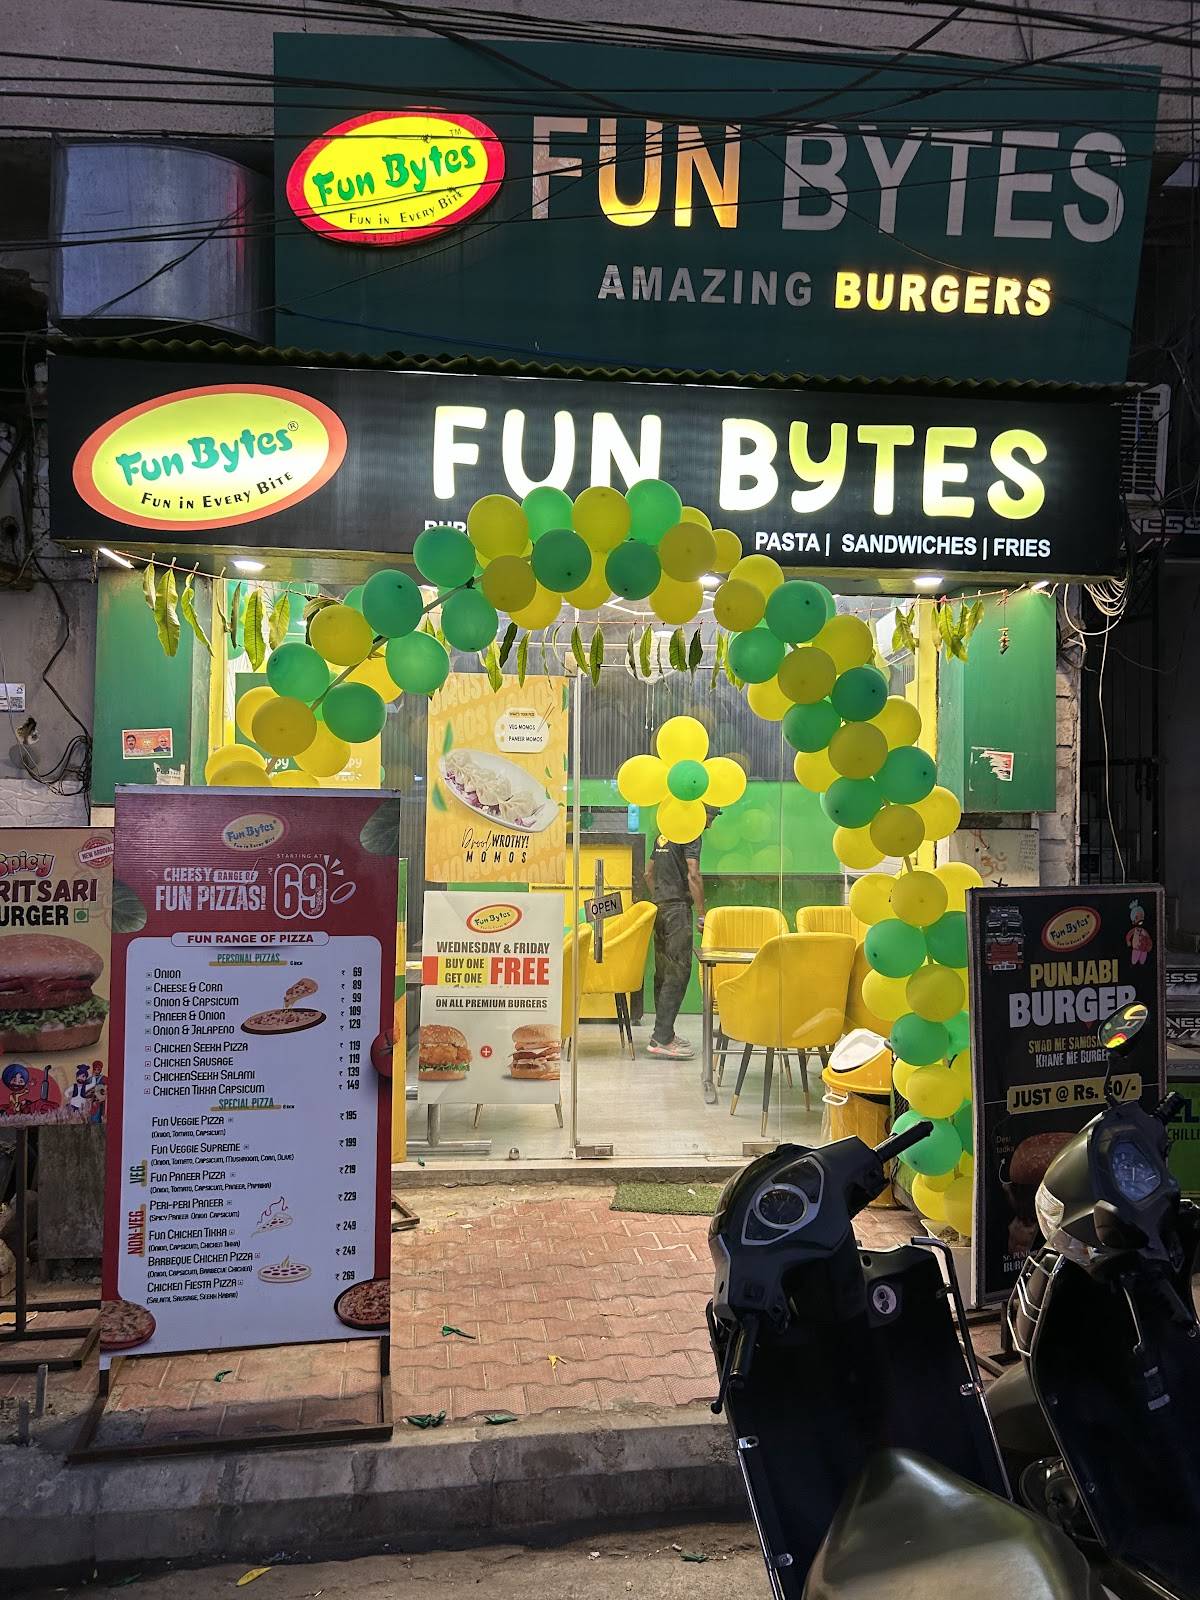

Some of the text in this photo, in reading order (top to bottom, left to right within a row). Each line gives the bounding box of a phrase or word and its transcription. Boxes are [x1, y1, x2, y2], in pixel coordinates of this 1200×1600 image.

[312, 145, 476, 206] Fun Bytes
[532, 116, 1126, 242] FUN BYTES
[598, 265, 1052, 316] AMAZING BURGERS
[116, 451, 184, 486] Fun
[188, 428, 292, 472] Bytes
[433, 406, 1048, 520] FUN BYTES
[841, 533, 977, 556] SANDWICHES
[993, 538, 1051, 558] FRIES
[492, 834, 530, 849] WROTHY!
[466, 851, 527, 863] MOMOS
[164, 867, 214, 882] CHEESY
[218, 871, 242, 881] RANGE
[274, 862, 328, 920] 69
[156, 885, 266, 911] FUN PIZZAS!
[592, 899, 617, 916] OPEN
[187, 934, 314, 944] FUN RANGE OF PIZZA
[437, 942, 550, 954] WEDNESDAY & FRIDAY
[217, 954, 252, 962] PERSONAL
[254, 953, 280, 962] PIZZAS
[446, 958, 484, 968] BUY ONE
[352, 966, 362, 976] 69
[490, 957, 550, 985] FREE
[1030, 959, 1119, 988] PUNJABI
[444, 972, 482, 984] GET ONE
[189, 982, 196, 992] &
[352, 980, 362, 990] 89
[182, 997, 190, 1006] &
[352, 993, 362, 1002] 99
[436, 998, 548, 1008] ON ALL PREMIUM BURGERS
[189, 1010, 196, 1020] &
[349, 1006, 361, 1016] 109
[182, 1025, 190, 1034] &
[349, 1019, 360, 1028] 129
[349, 1041, 360, 1050] 119
[1028, 1040, 1052, 1054] SWAD
[1054, 1038, 1066, 1052] ME
[349, 1054, 360, 1064] 119
[1036, 1053, 1064, 1068] KHANE
[1067, 1052, 1078, 1065] ME
[348, 1067, 360, 1076] 139
[347, 1080, 360, 1090] 149
[1013, 1088, 1052, 1108] JUST
[1056, 1086, 1068, 1102] @
[1074, 1084, 1098, 1100] Rs.
[218, 1099, 248, 1109] SPECIAL
[252, 1098, 274, 1108] PIZZA
[130, 1165, 146, 1184] VEG
[128, 1210, 144, 1254] NON-VEG
